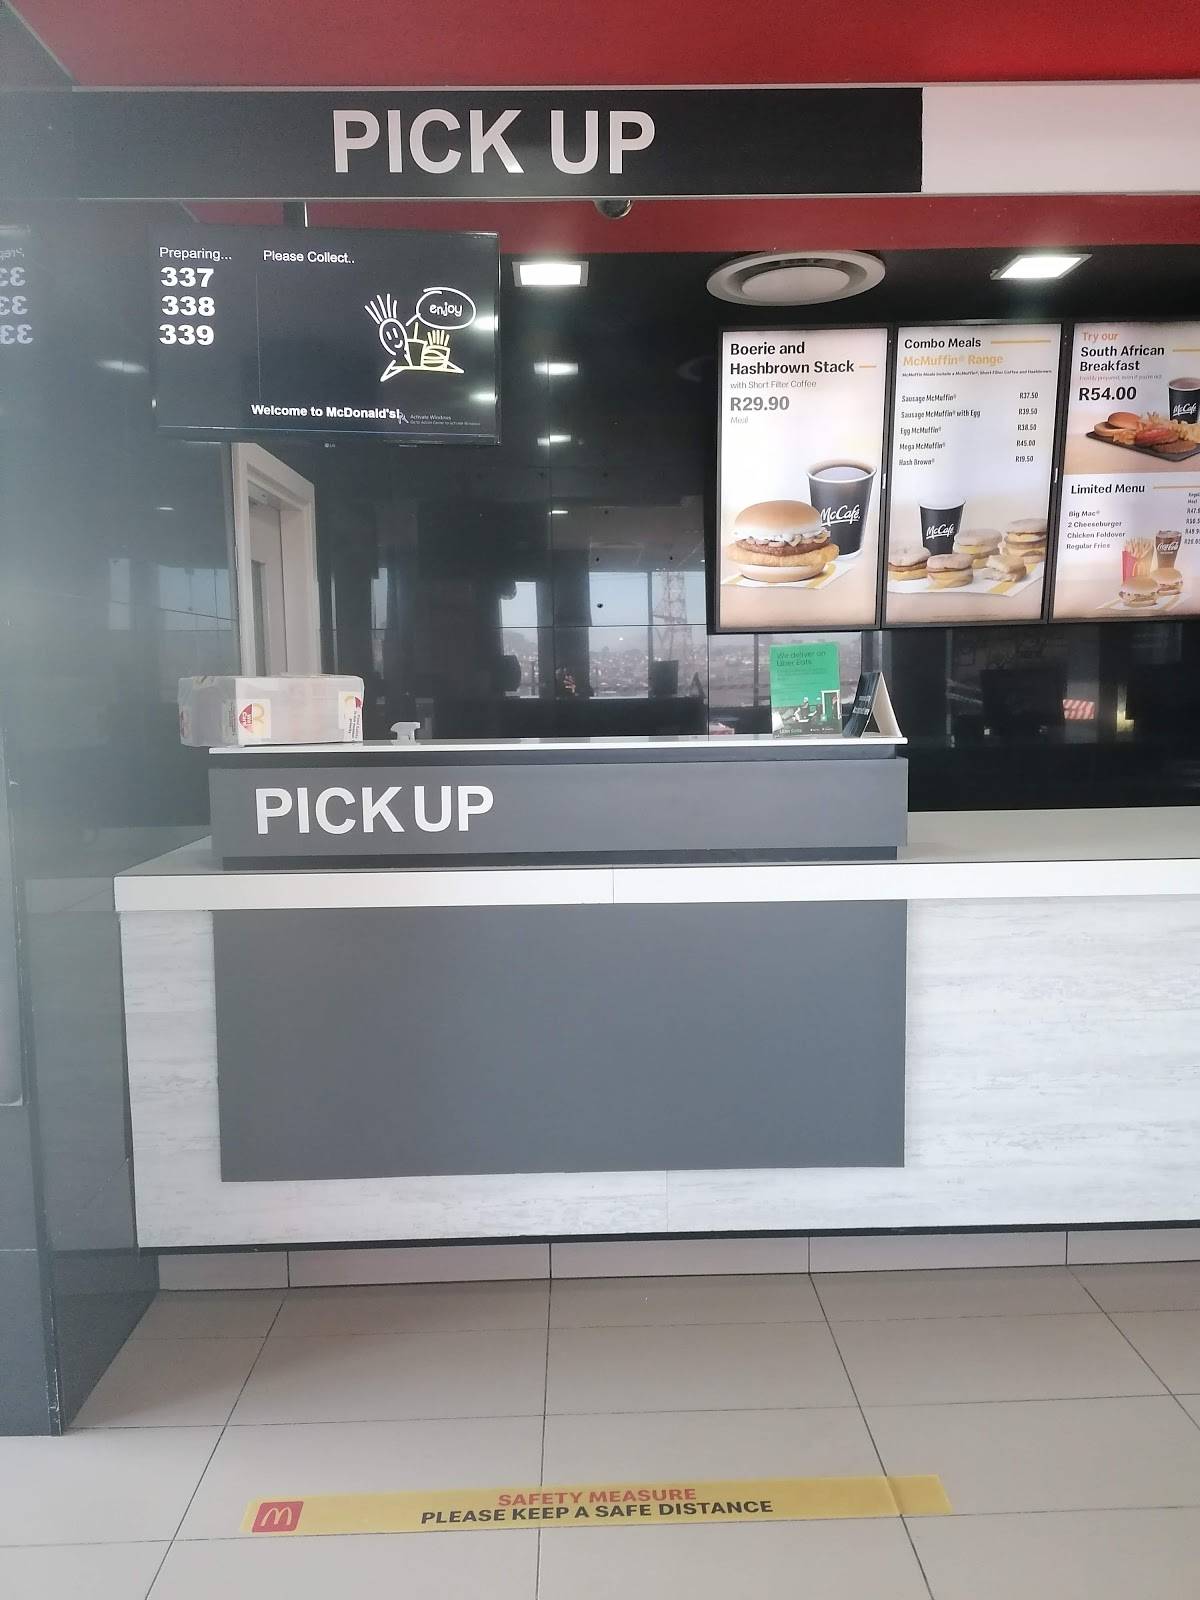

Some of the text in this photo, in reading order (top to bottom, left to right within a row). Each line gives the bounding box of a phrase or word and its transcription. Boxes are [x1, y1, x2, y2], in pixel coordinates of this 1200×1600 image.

[333, 108, 656, 175] PICK UP
[159, 246, 232, 262] Preparing...
[263, 250, 355, 263] Please Collect..
[160, 266, 215, 287] 337
[161, 295, 216, 317] 338
[429, 301, 463, 317] enjoy
[158, 323, 215, 346] 339
[1082, 332, 1119, 343] Try our
[730, 341, 805, 355] Boerie and
[904, 337, 982, 349] Combo Meals
[1080, 344, 1165, 357] South African
[967, 354, 1004, 367] Range
[1080, 360, 1141, 372] Breakfast
[730, 360, 855, 375] Hashbrown Stack
[730, 380, 817, 389] with Short Filter Coffee
[901, 395, 925, 403] Sausage
[1078, 386, 1137, 401] R54.00
[730, 396, 790, 411] R29.90
[251, 404, 307, 417] Welcome
[310, 405, 323, 417] to
[901, 411, 925, 419] Sausage
[956, 409, 970, 417] with
[970, 410, 981, 419] Egg
[900, 427, 911, 436] Egg
[899, 443, 915, 452] Mega
[1071, 484, 1145, 495] Limited Menu
[1073, 521, 1122, 529] Cheeseburger
[1066, 543, 1092, 551] Regular
[255, 785, 494, 835] PICK UP
[498, 1488, 697, 1507] SAFETY MEASURE
[421, 1500, 774, 1524] PLEASE KEEP A SAFE DISTANCE
